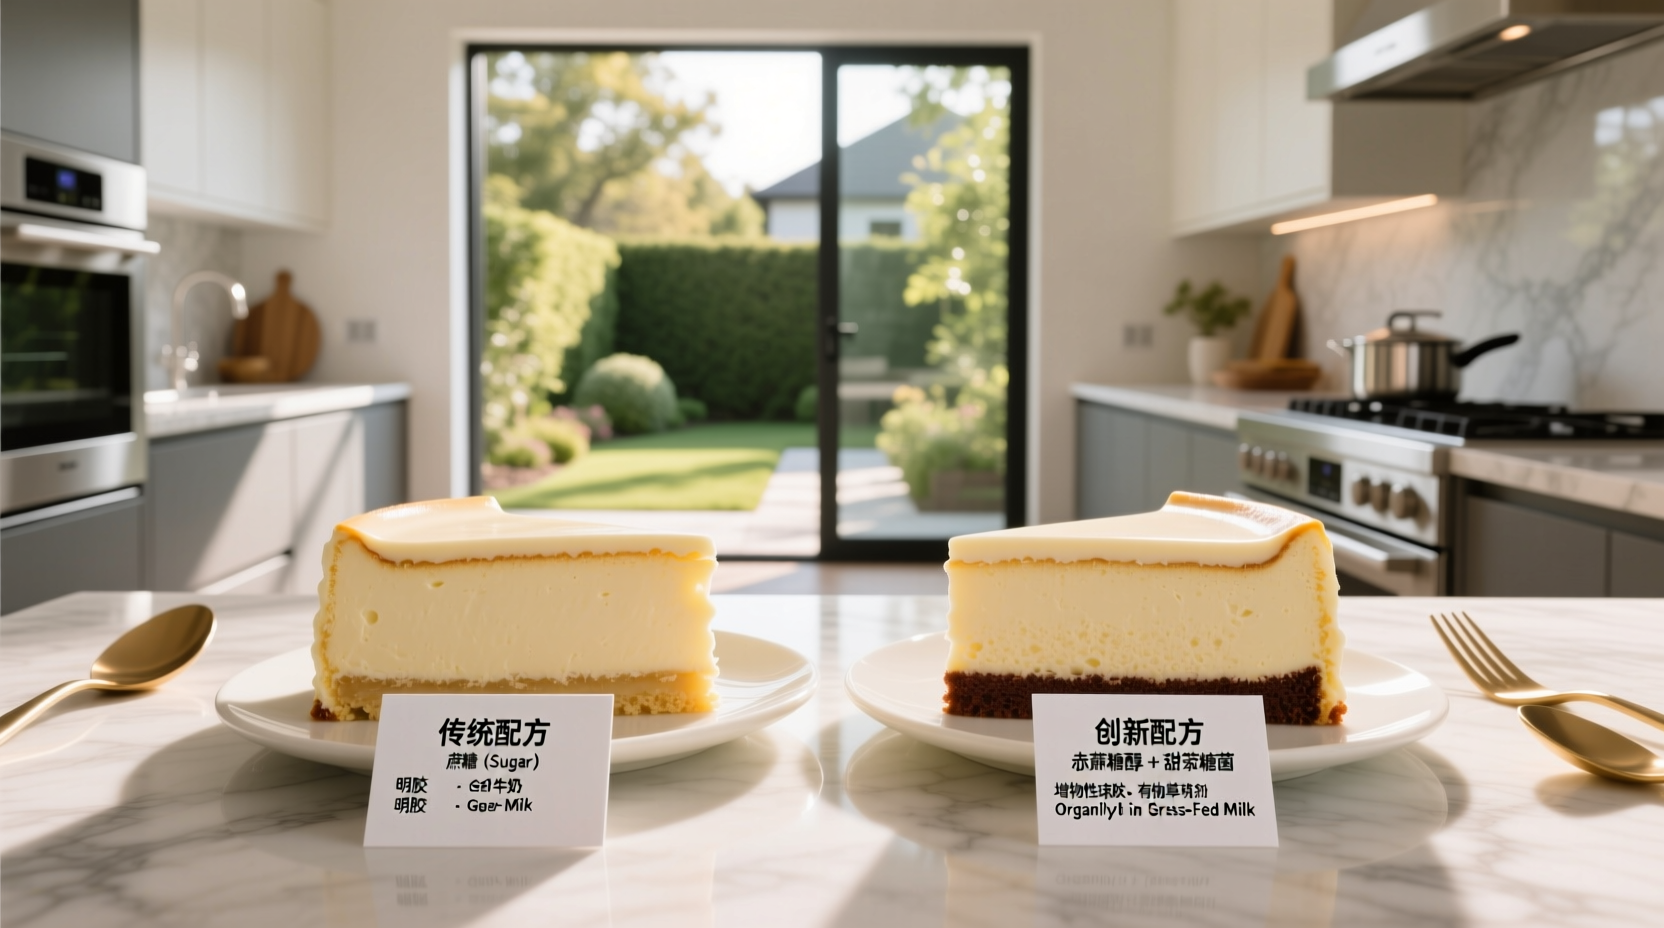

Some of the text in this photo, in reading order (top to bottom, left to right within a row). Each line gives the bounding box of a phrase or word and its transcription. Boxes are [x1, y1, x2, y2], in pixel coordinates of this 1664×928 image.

[438, 717, 551, 747] 传统配方
[1094, 717, 1205, 747] 创新配方
[484, 752, 540, 773] (Sugar)
[1147, 755, 1160, 769] +
[1128, 801, 1143, 817] in
[1223, 801, 1256, 817] Milk
